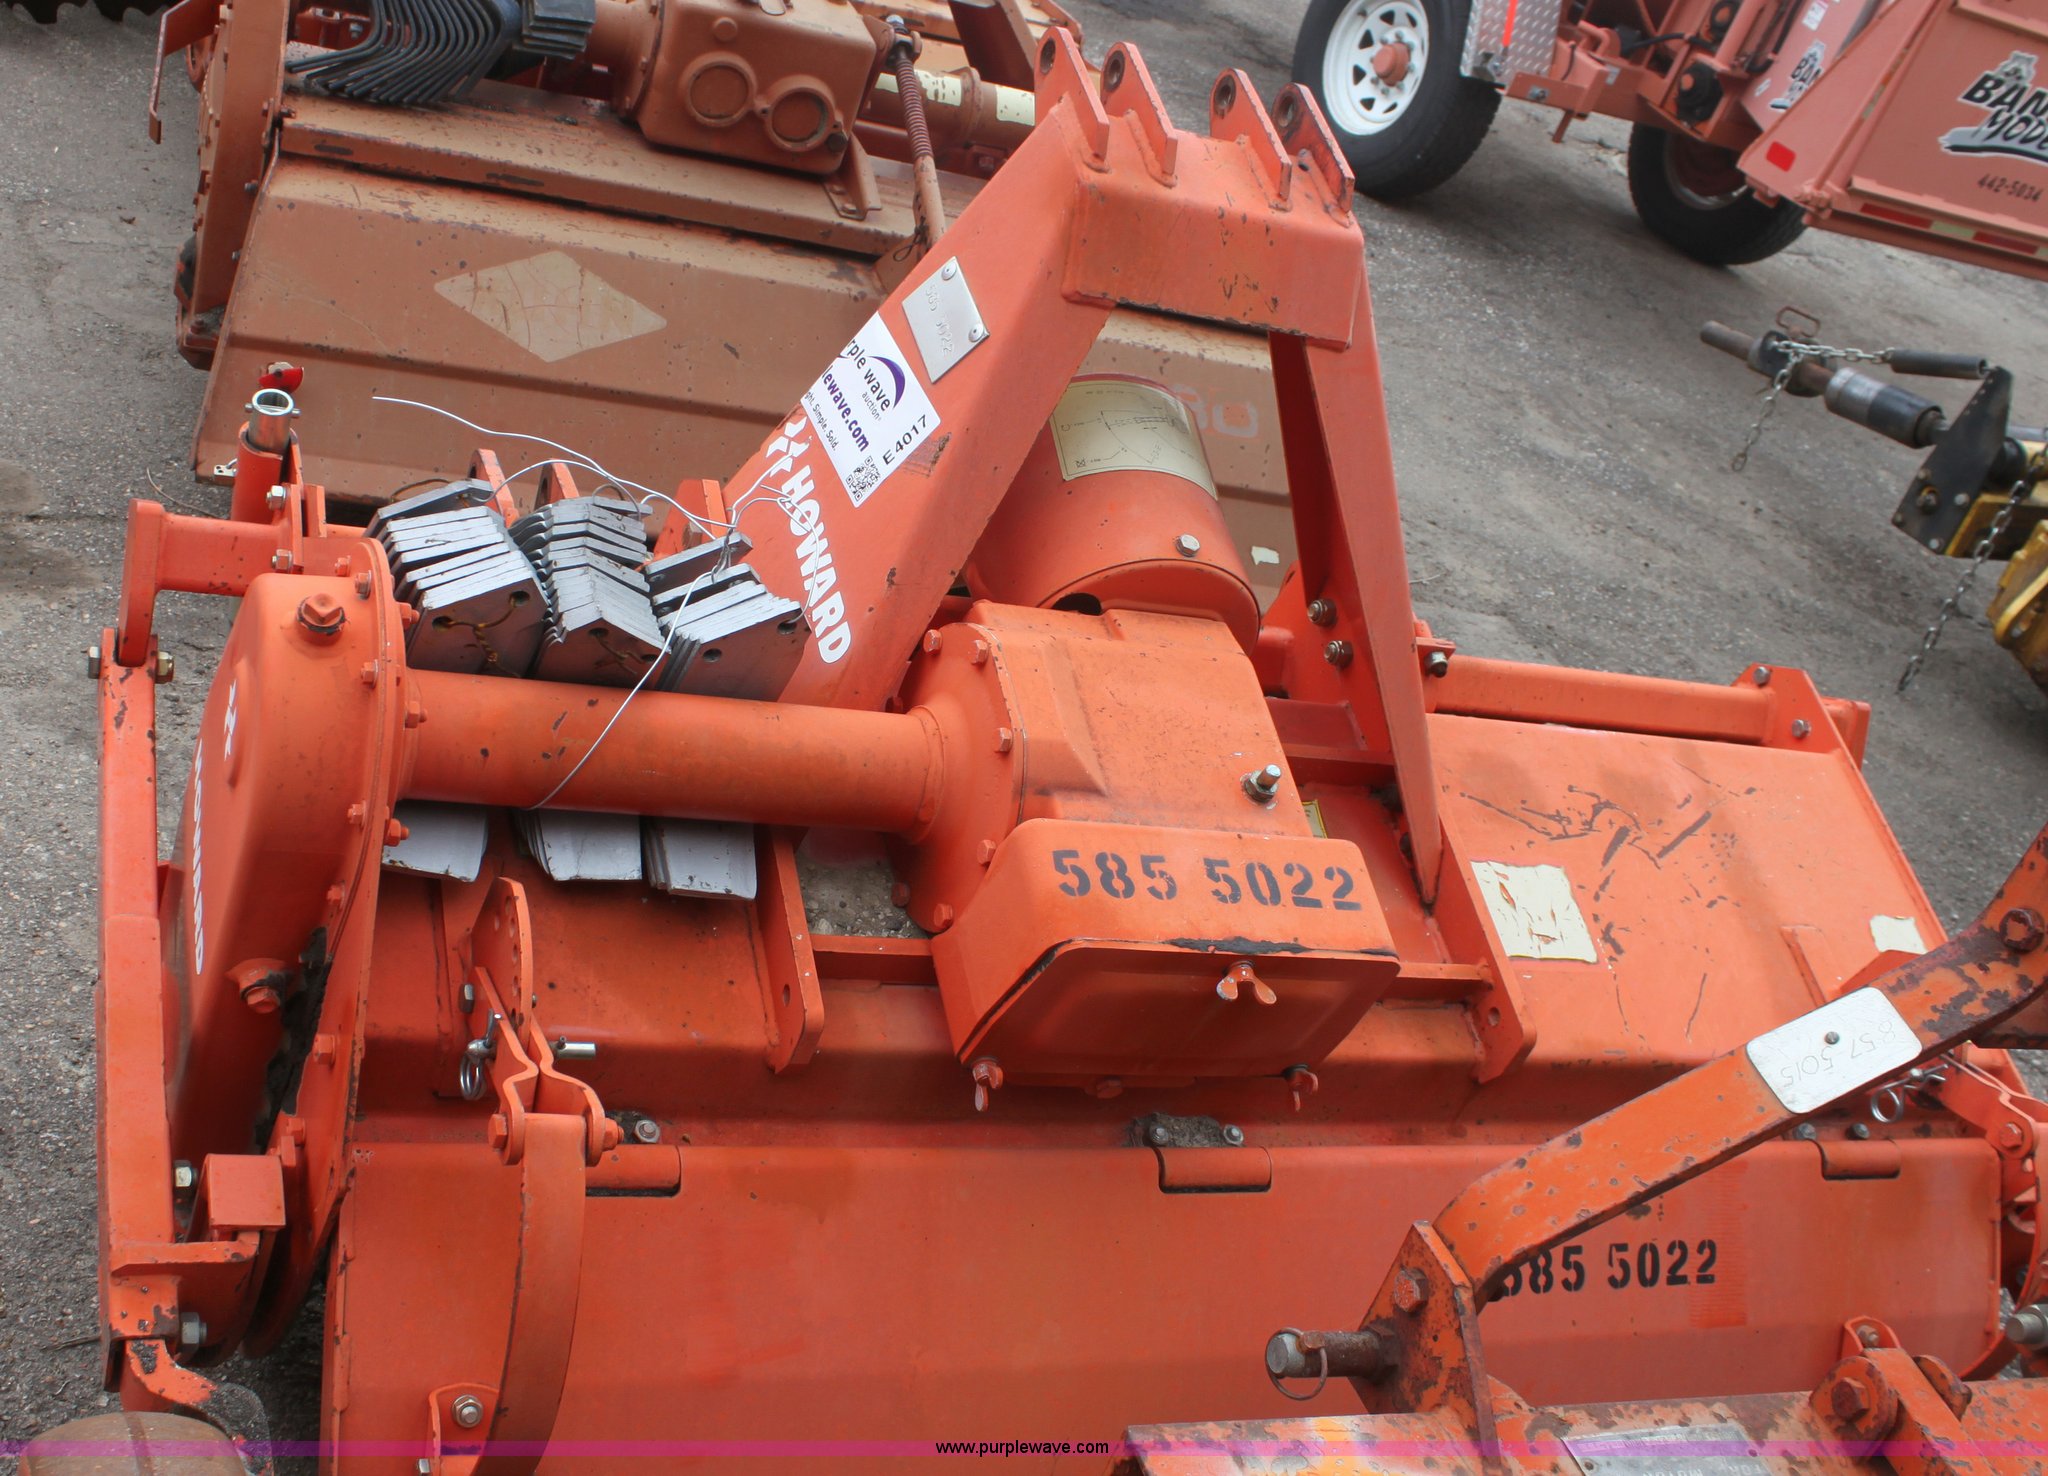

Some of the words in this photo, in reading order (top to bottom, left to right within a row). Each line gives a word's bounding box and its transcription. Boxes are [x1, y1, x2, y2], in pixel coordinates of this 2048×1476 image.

[864, 368, 891, 412] wave
[882, 449, 895, 465] E
[895, 414, 928, 452] 4017
[781, 464, 852, 664] HOWARD
[1052, 849, 1178, 900] 585
[1203, 857, 1362, 911] 5022
[1607, 1239, 1717, 1289] 5022
